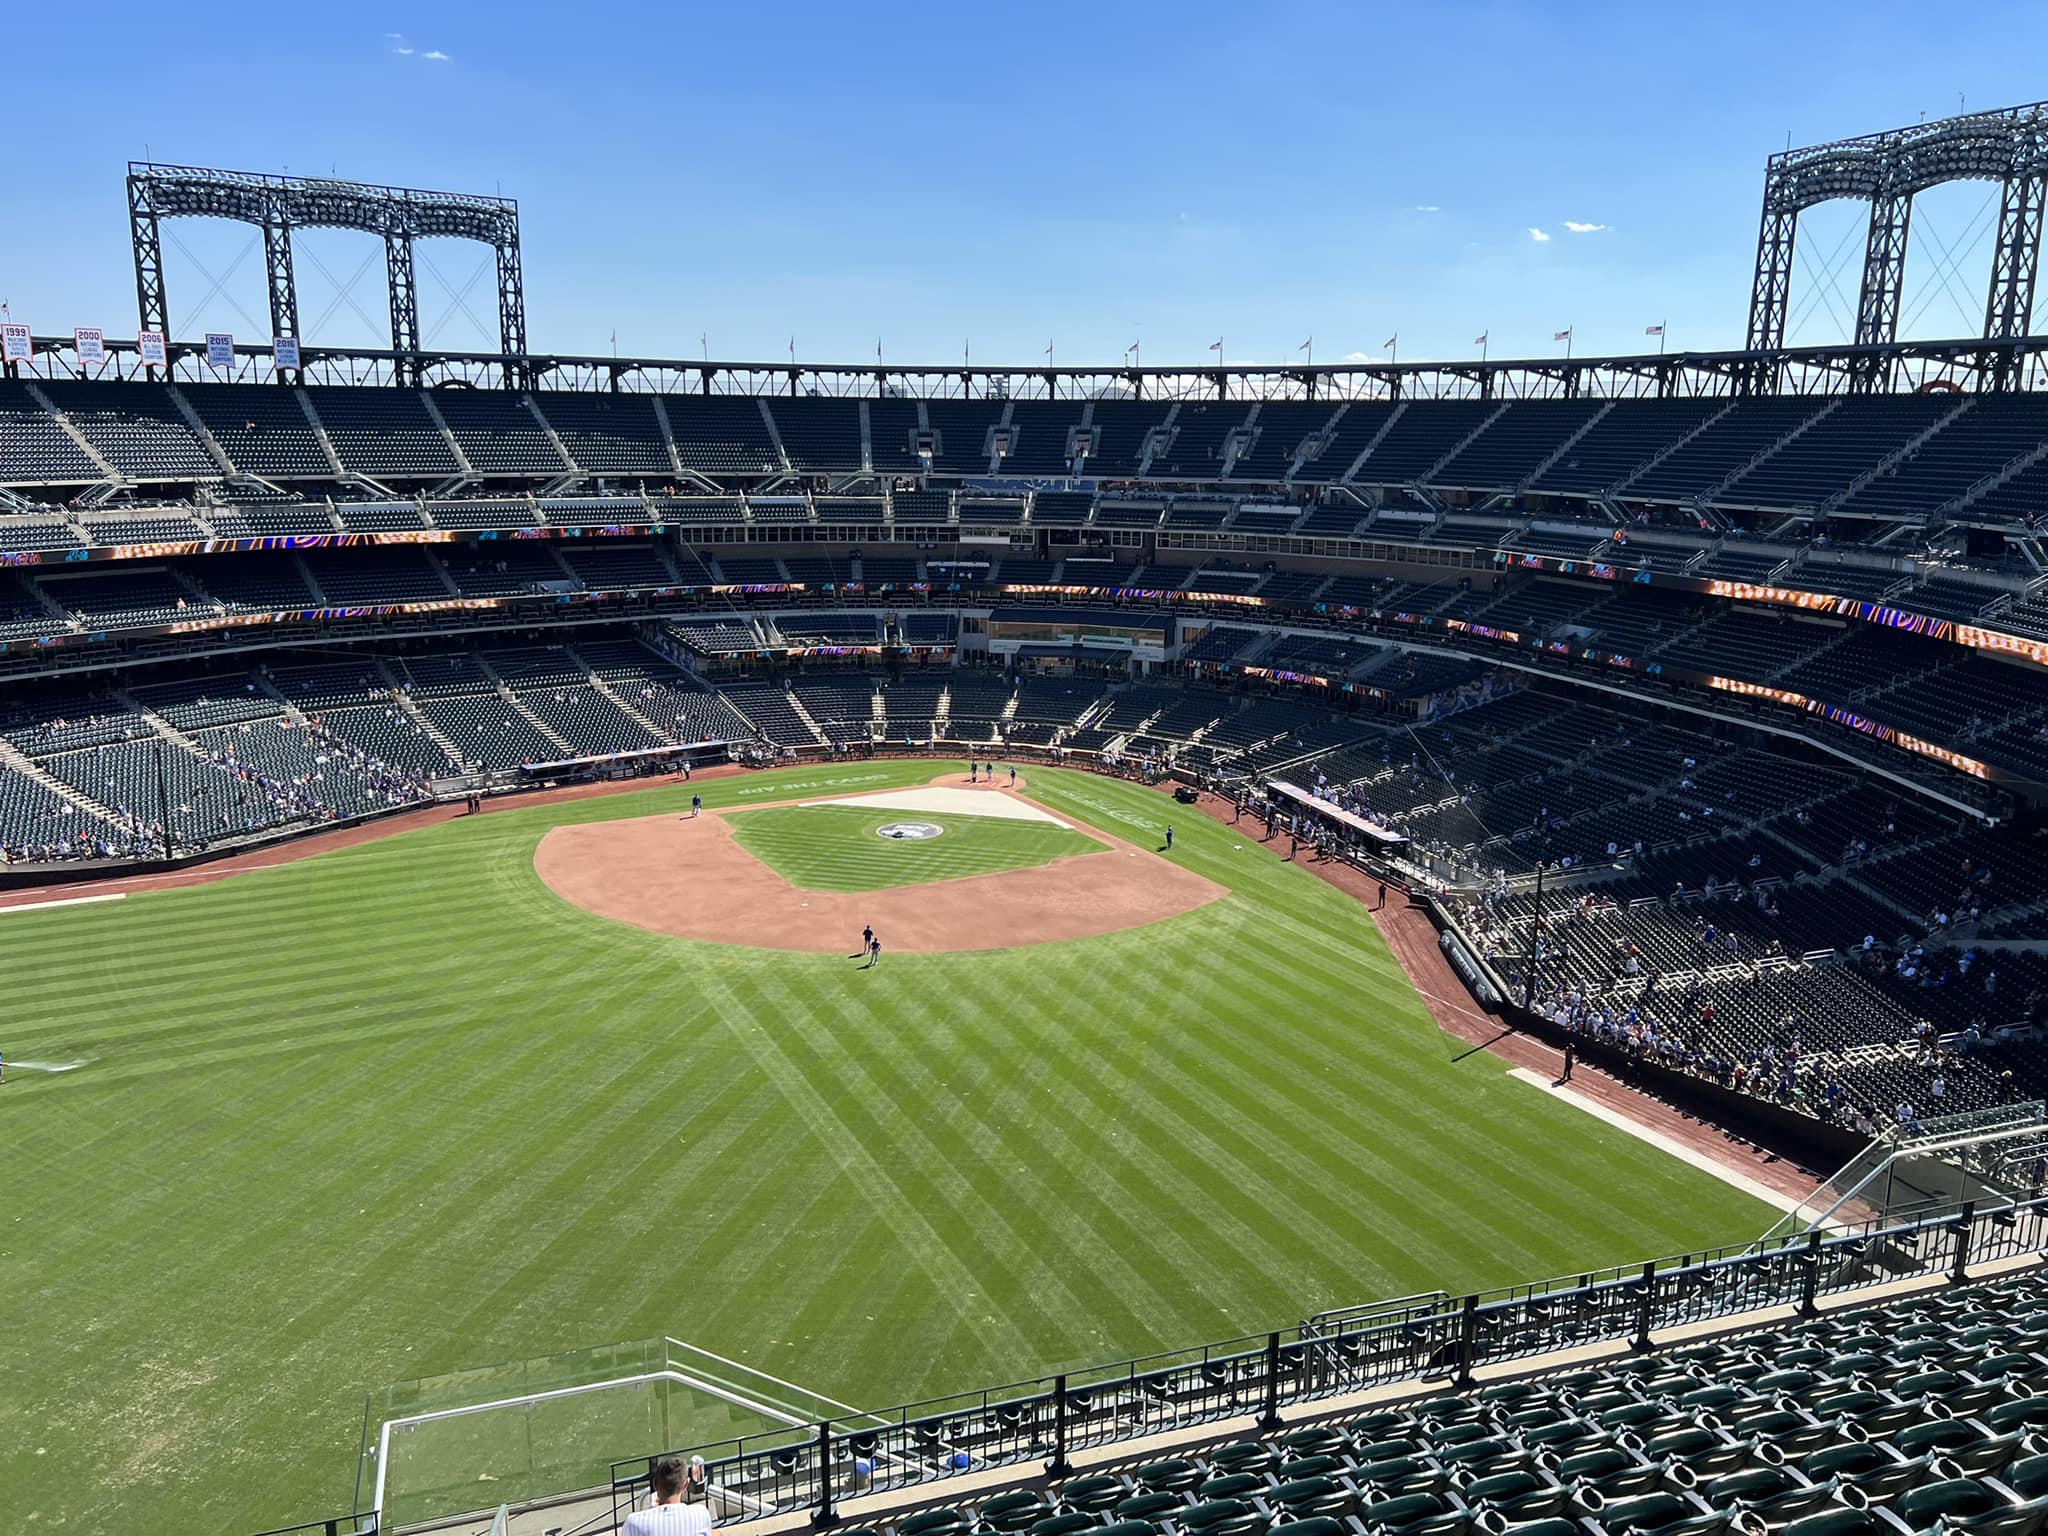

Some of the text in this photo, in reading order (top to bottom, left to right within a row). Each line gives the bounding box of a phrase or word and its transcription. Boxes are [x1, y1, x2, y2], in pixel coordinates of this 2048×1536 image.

[6, 327, 26, 337] 1999
[78, 331, 100, 340] 2000
[142, 334, 162, 343] 2006
[209, 336, 230, 345] 2015
[276, 339, 296, 348] 2016
[738, 785, 776, 796] APP
